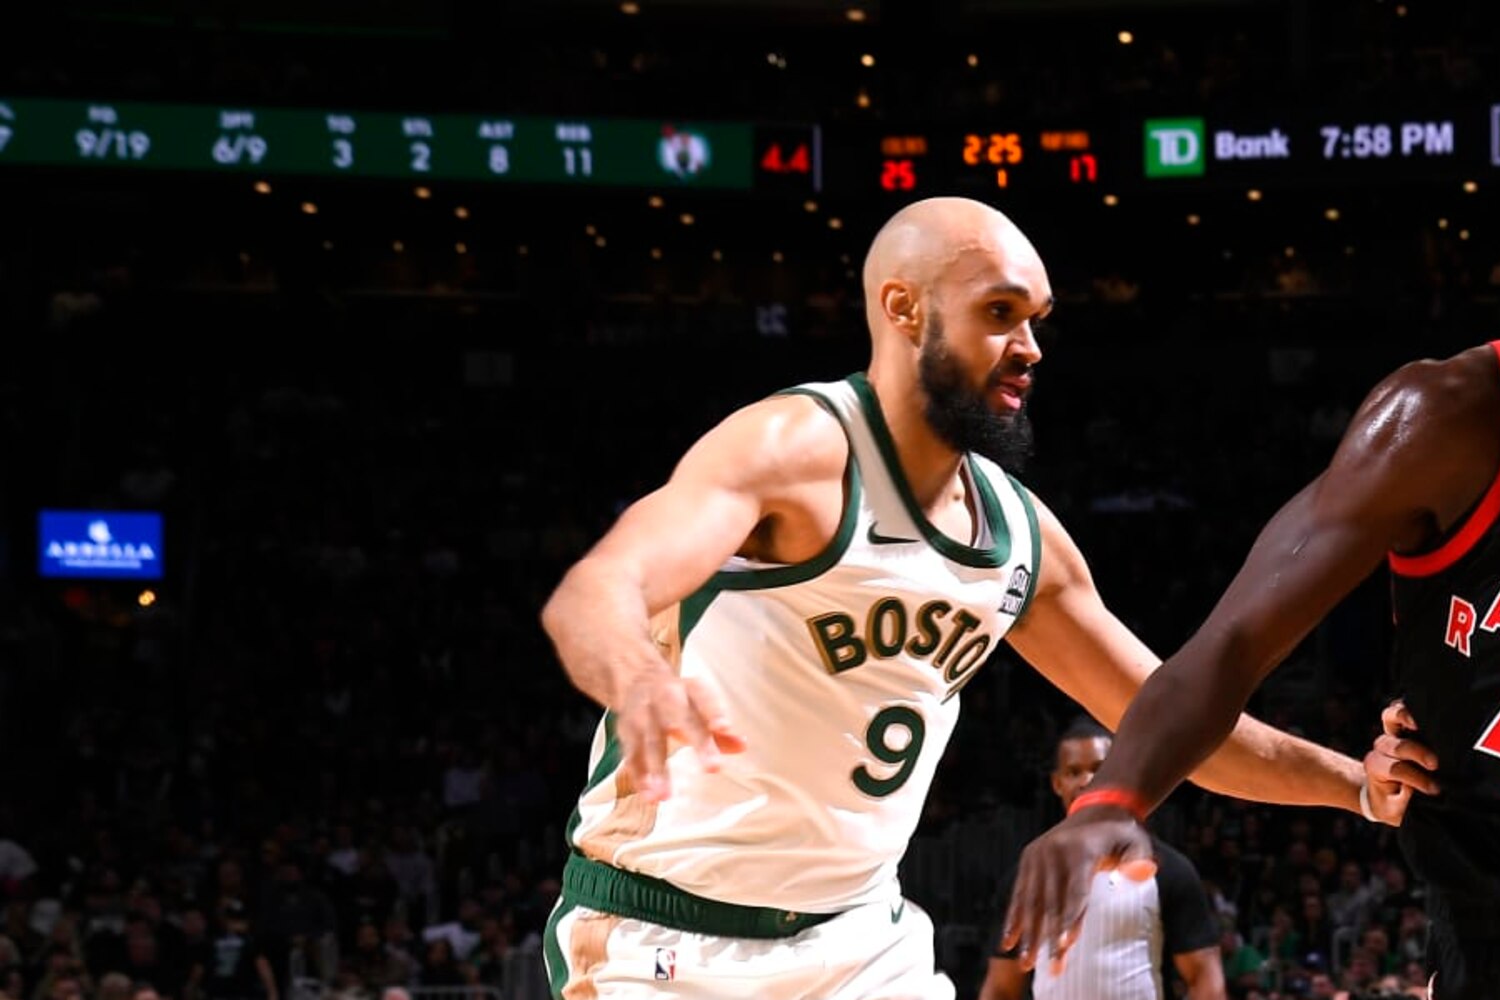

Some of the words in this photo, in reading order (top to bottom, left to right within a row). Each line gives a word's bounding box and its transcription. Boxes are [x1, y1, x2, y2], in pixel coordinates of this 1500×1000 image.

[76, 129, 150, 158] 9/19
[212, 135, 267, 164] 6/9
[333, 139, 353, 168] 3
[411, 142, 431, 171] 2
[489, 145, 509, 174] 8
[563, 147, 592, 175] 11
[1151, 128, 1199, 166] TD
[1214, 128, 1289, 160] Bank
[1320, 124, 1393, 158] 7:58
[1400, 121, 1454, 155] PM
[851, 706, 926, 797] 9
